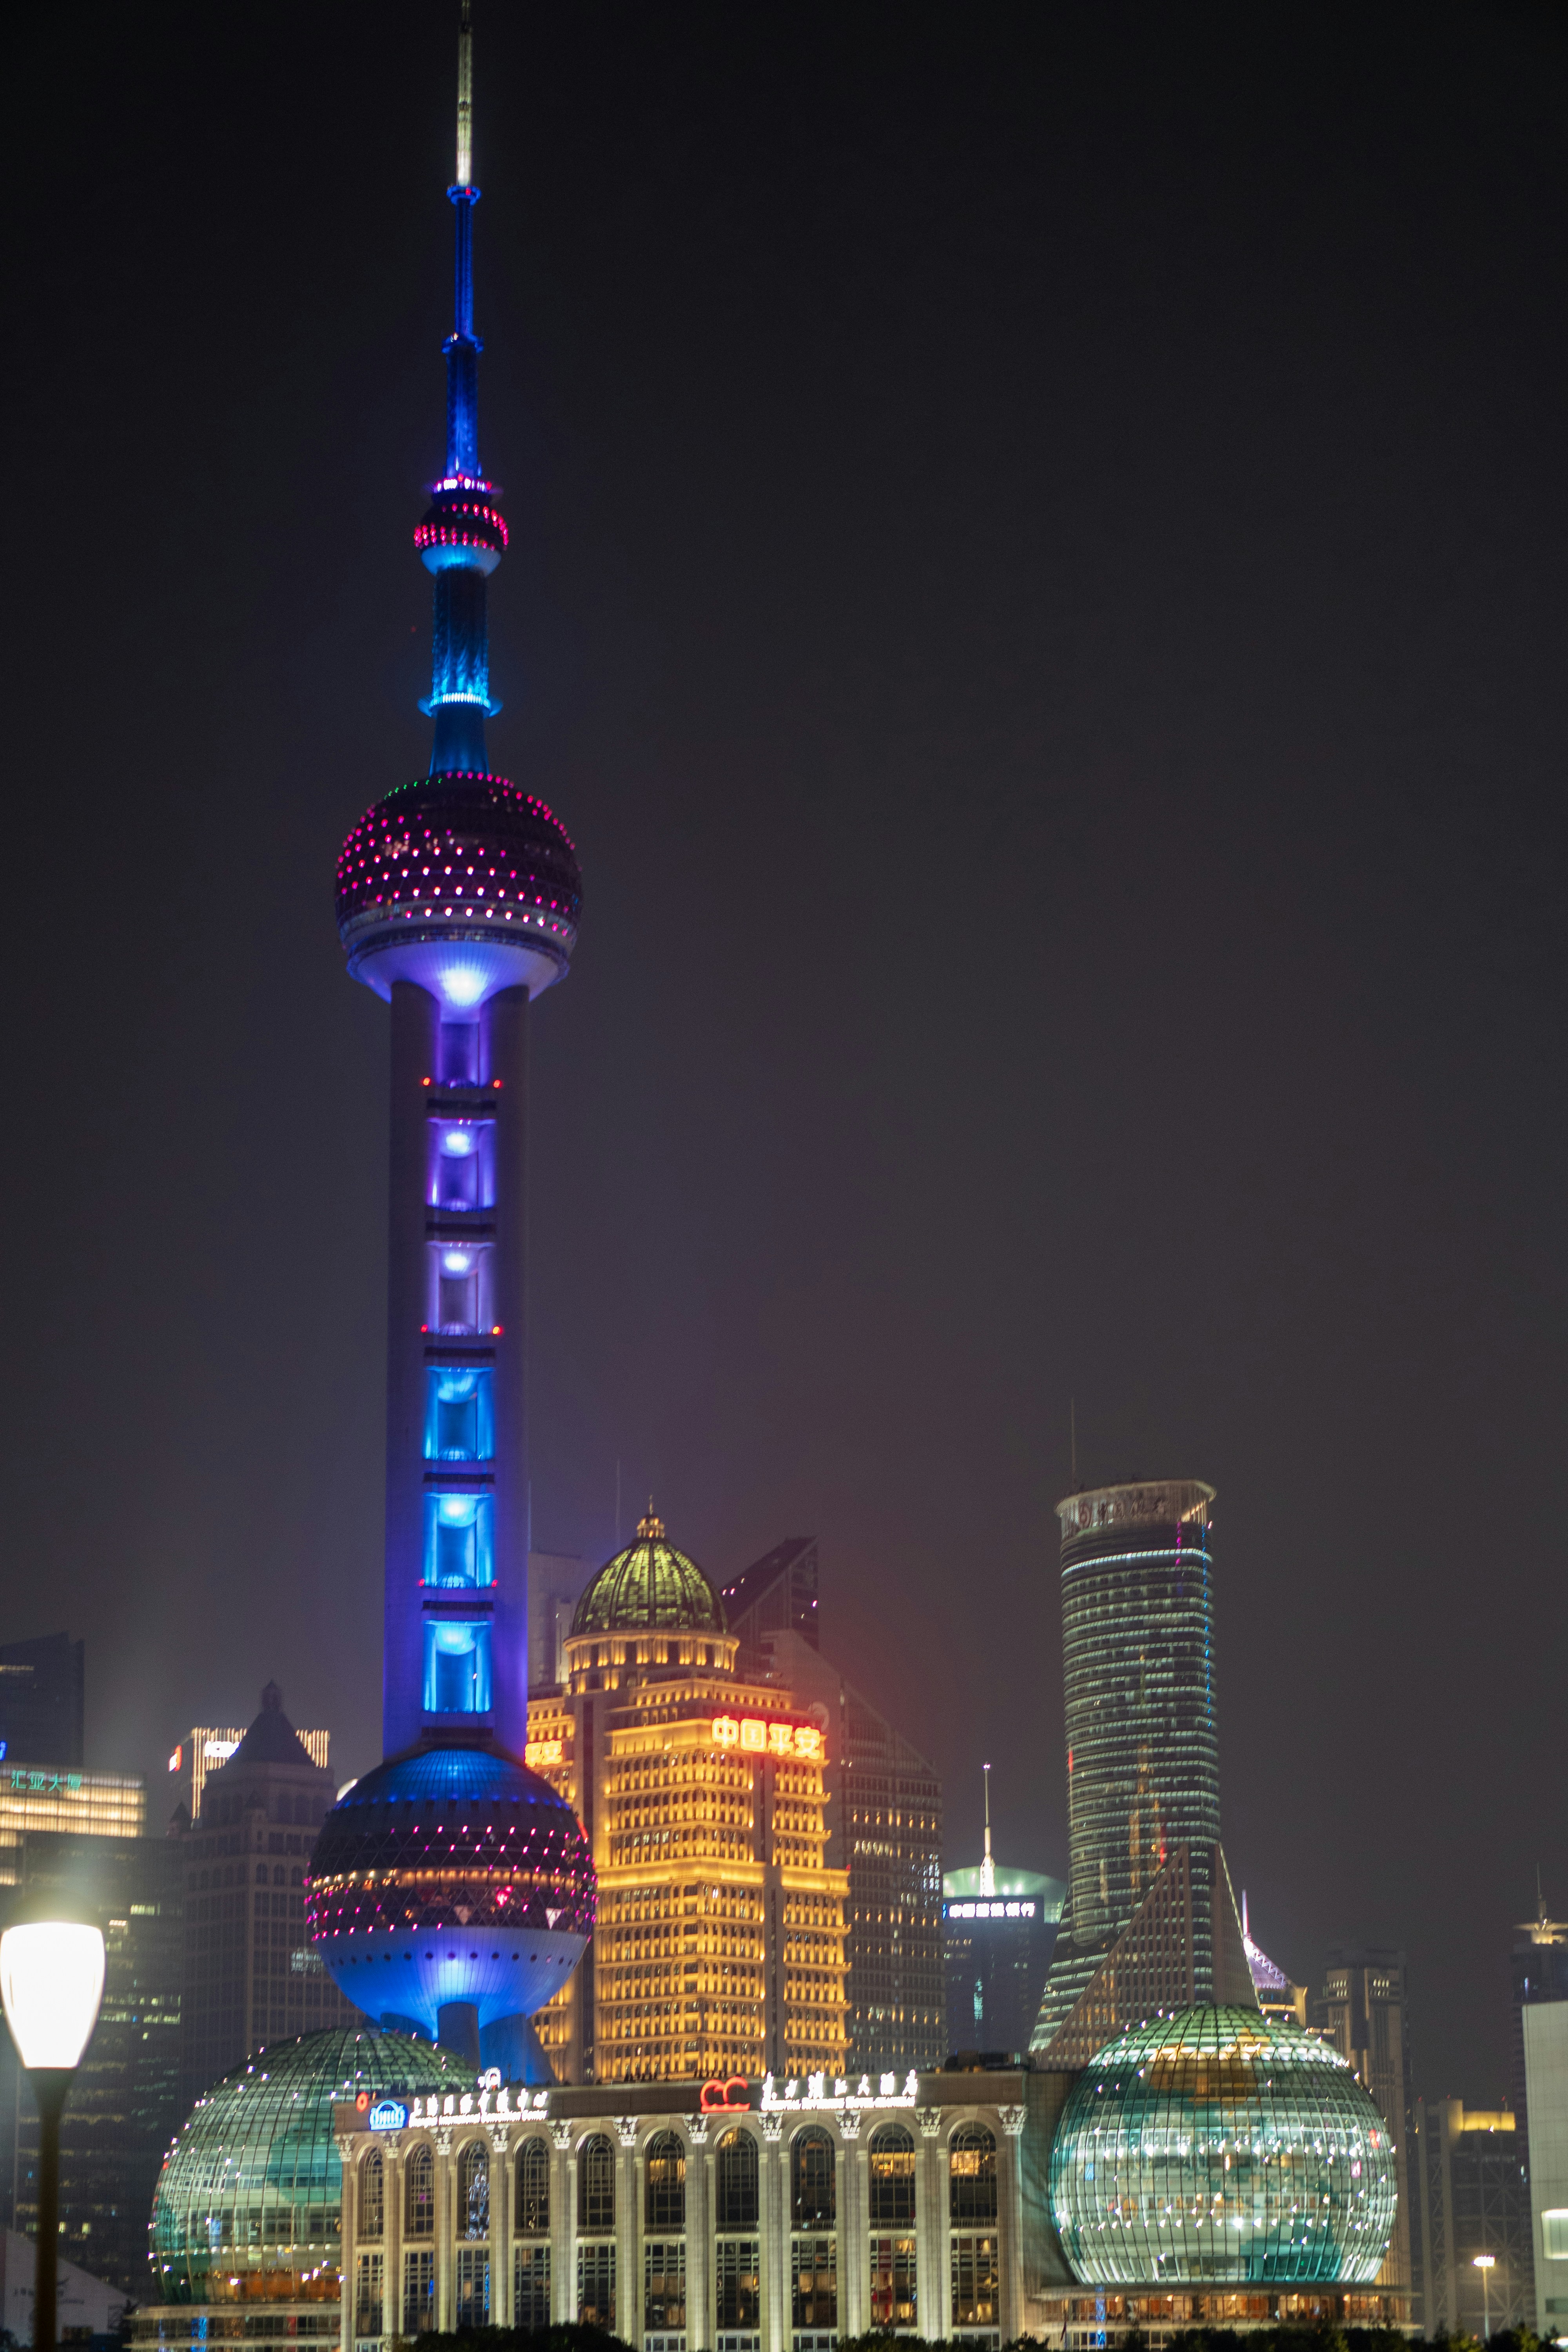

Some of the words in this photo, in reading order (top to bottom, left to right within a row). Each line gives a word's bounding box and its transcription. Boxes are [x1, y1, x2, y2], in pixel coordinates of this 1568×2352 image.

[712, 1715, 820, 1759] 中国平安
[11, 1769, 82, 1792] 汇亚大厦
